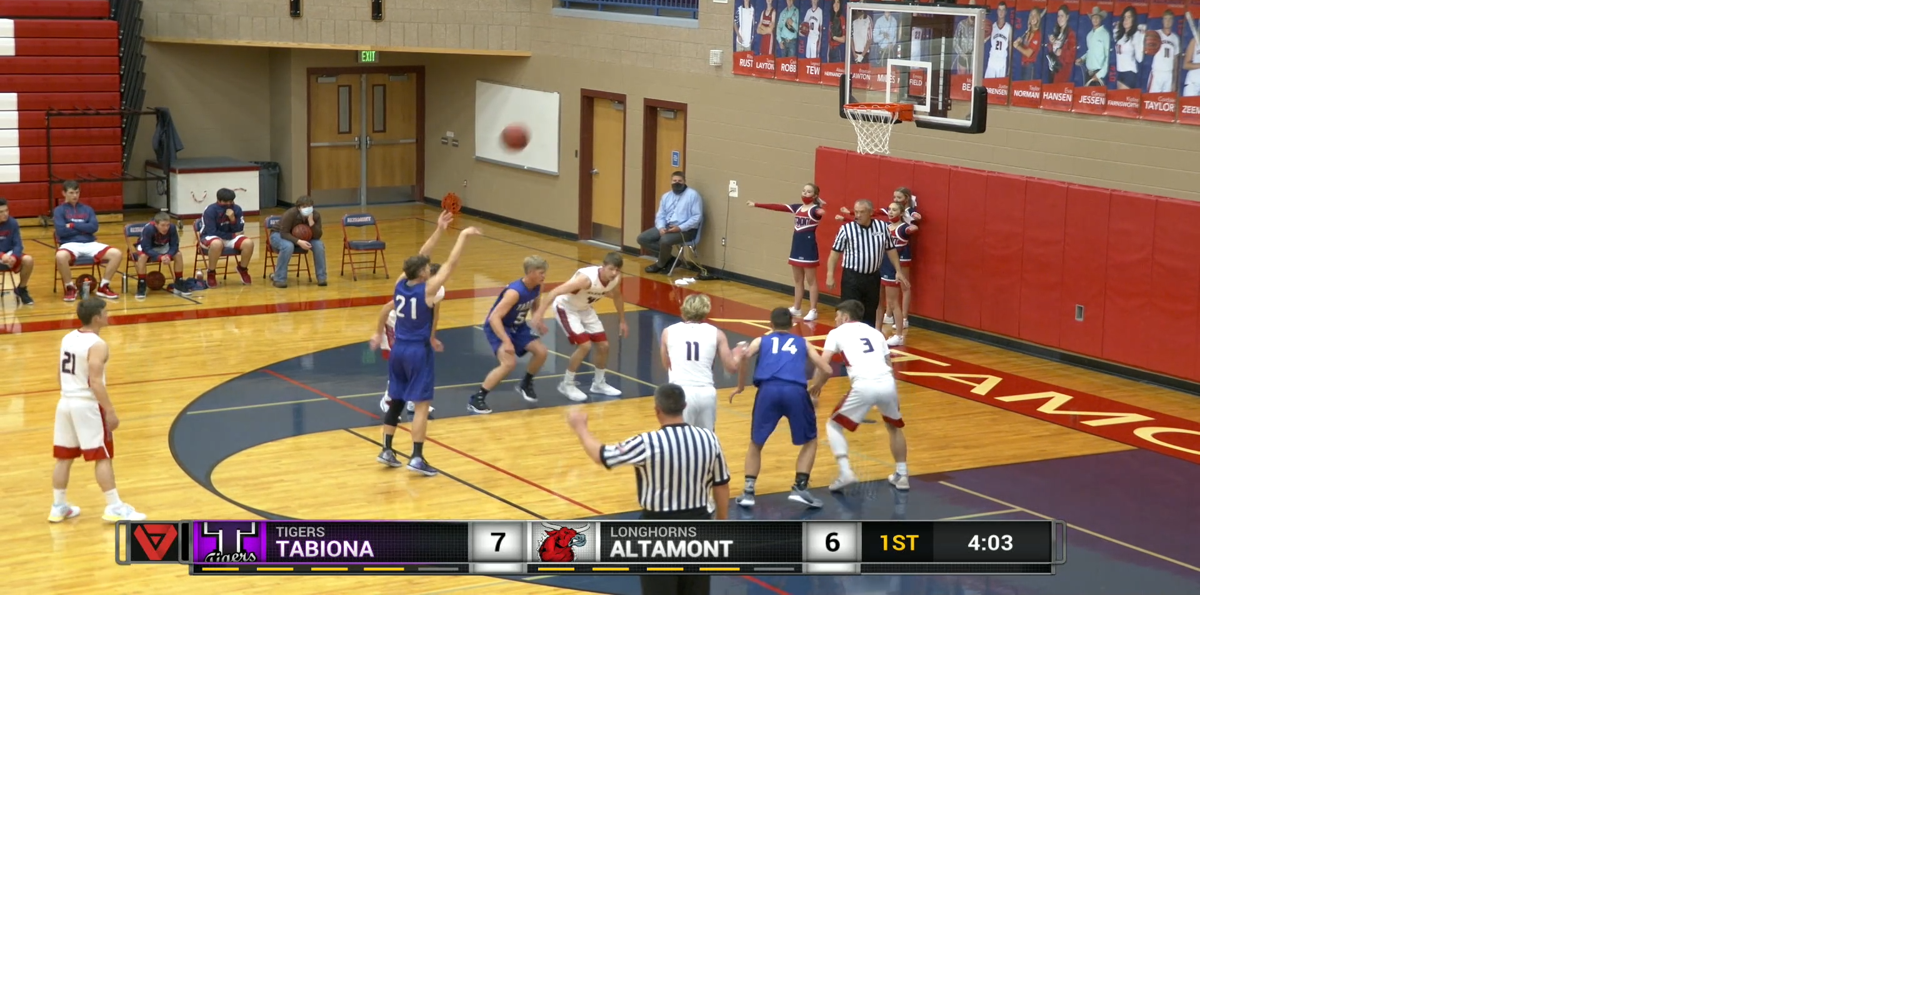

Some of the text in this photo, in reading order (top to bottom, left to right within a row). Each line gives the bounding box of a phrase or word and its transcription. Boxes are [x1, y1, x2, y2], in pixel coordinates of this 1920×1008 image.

[361, 50, 375, 62] EXIT
[739, 58, 753, 68] RUST
[756, 62, 775, 70] LAYTON
[781, 63, 797, 73] ROBB
[806, 65, 820, 75] TEW
[1013, 90, 1040, 99] NORMAN
[1043, 91, 1073, 102] HANSEN
[1078, 95, 1105, 106] JESSEN
[1143, 100, 1175, 112] TAYLOR
[395, 294, 417, 320] 21
[686, 341, 700, 361] 11
[770, 336, 798, 355] 14
[859, 337, 875, 354] 3
[61, 351, 76, 376] 21
